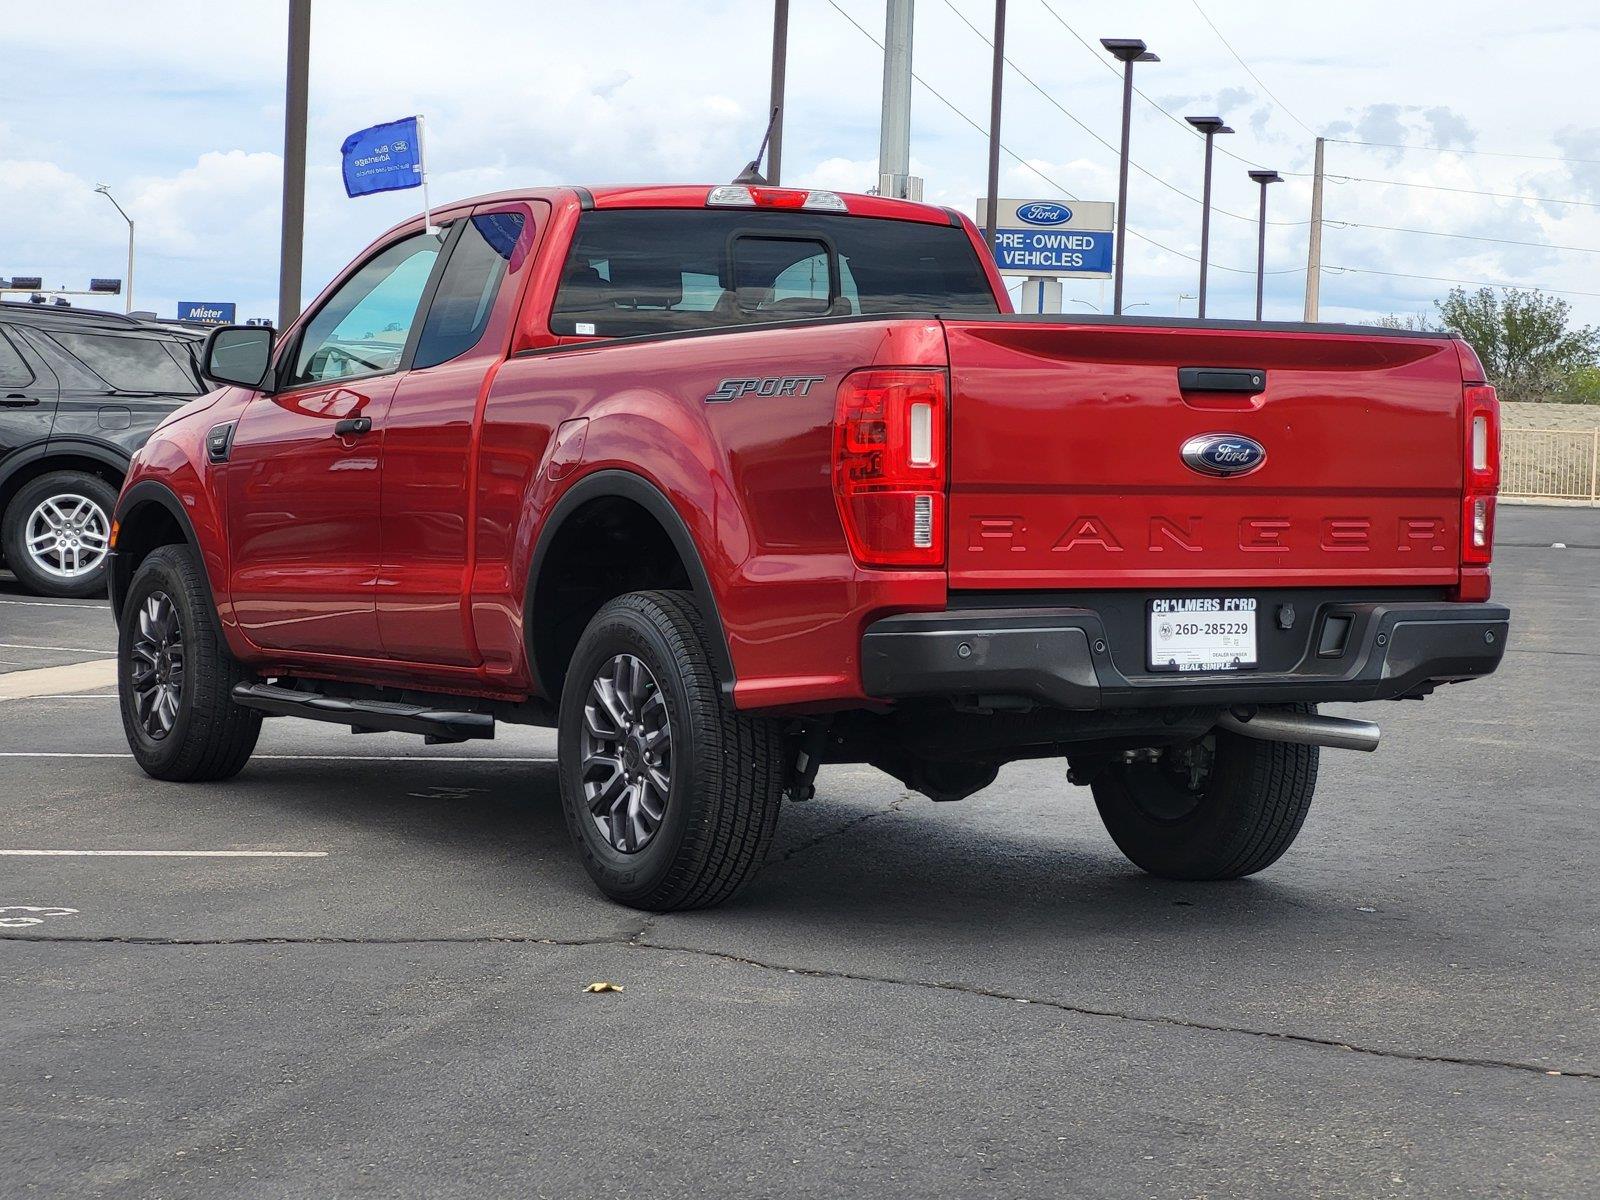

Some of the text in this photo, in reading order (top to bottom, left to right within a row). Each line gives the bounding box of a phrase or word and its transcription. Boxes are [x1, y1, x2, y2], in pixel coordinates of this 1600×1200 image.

[1027, 204, 1060, 220] Ford
[1003, 251, 1083, 266] VEHICLES
[189, 307, 223, 318] Mister
[704, 375, 826, 403] SPORT
[1214, 443, 1250, 462] Ford
[968, 515, 1446, 552] RANGER
[1175, 623, 1248, 635] 26D-285229
[1179, 663, 1200, 671] REAL
